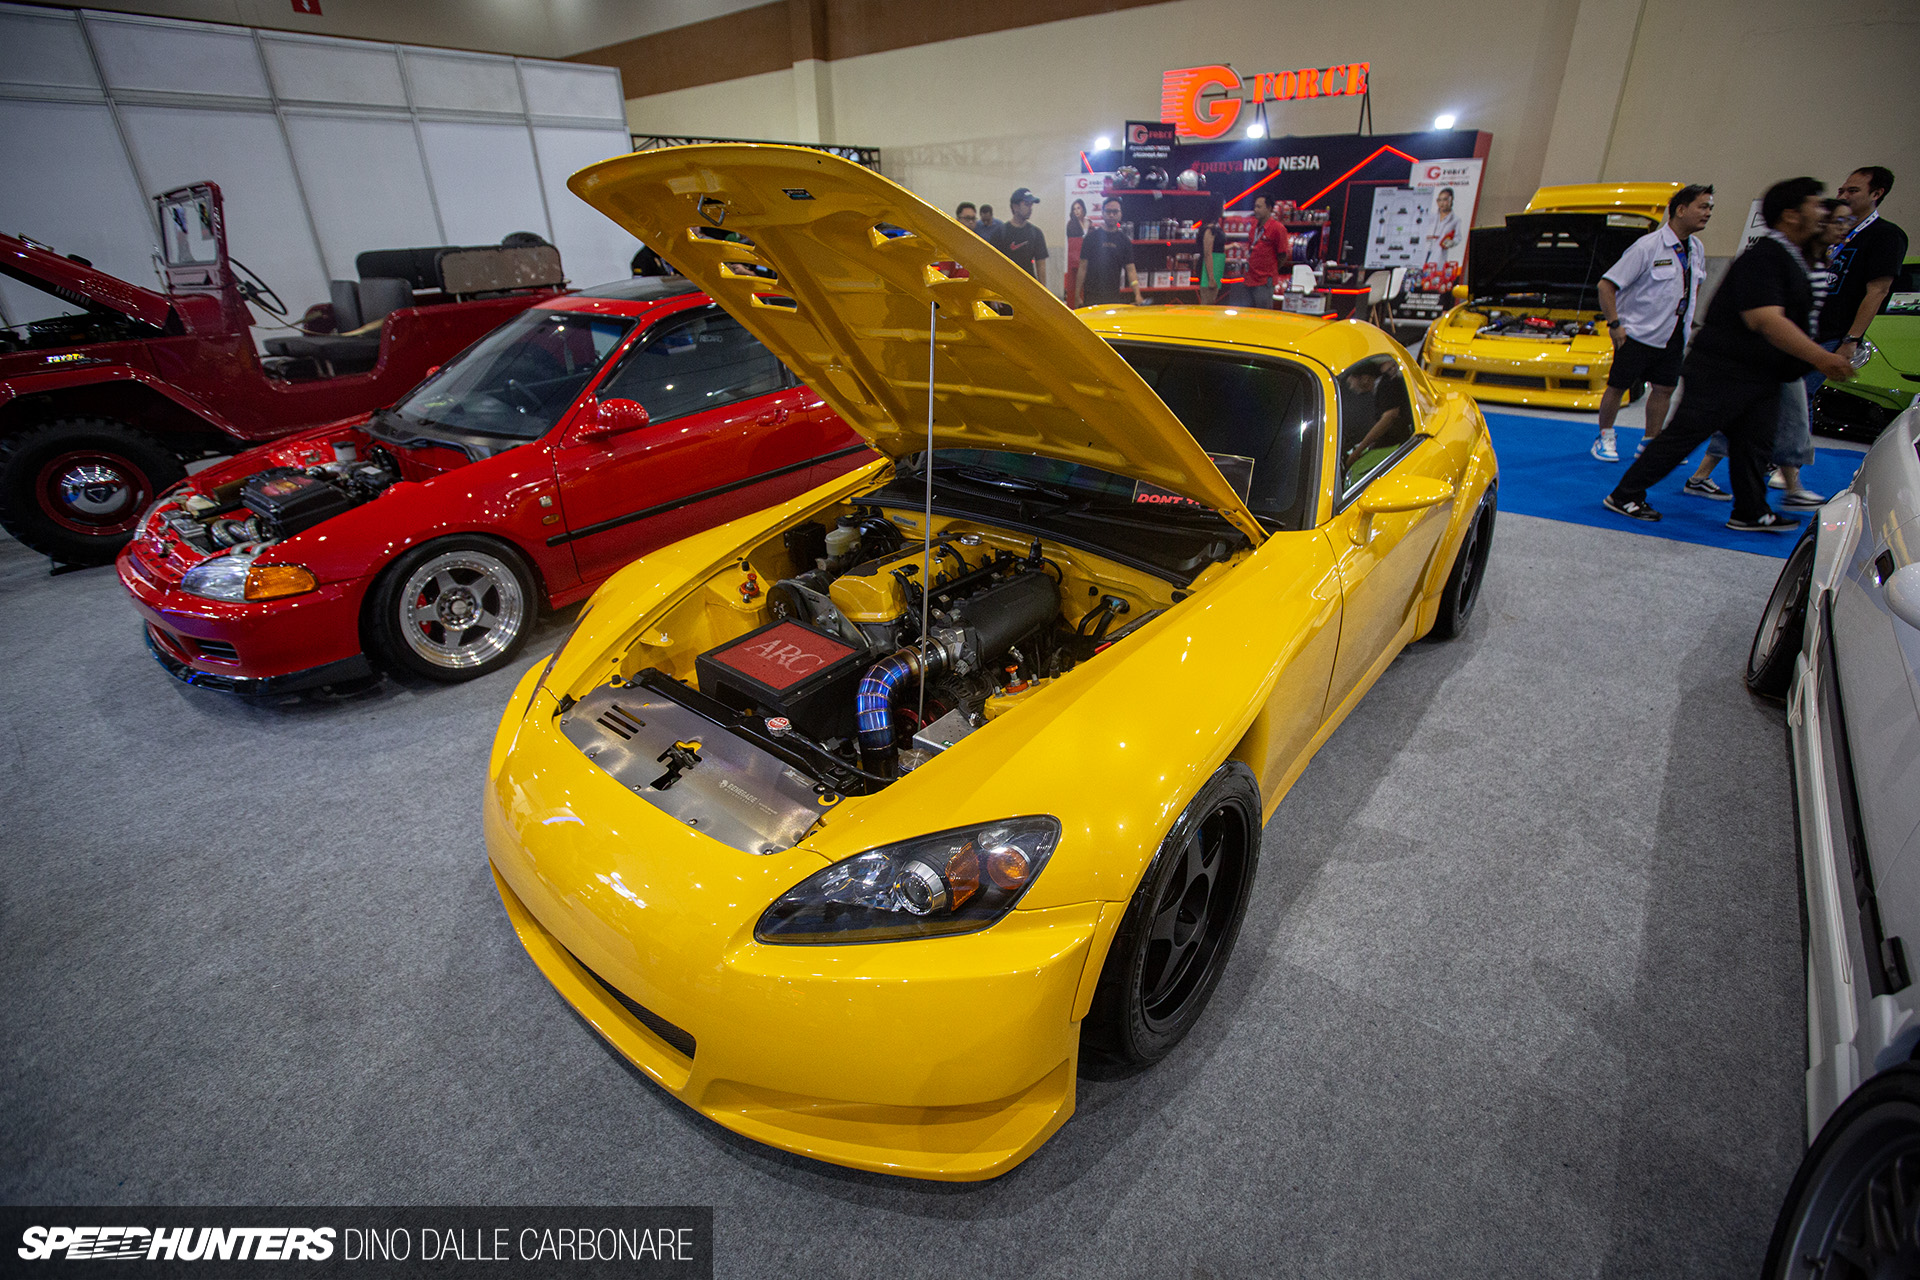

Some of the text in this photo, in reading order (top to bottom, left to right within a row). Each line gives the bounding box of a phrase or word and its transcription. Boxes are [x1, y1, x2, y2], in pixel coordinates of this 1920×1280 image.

[1161, 62, 1370, 139] G FORCE
[1128, 124, 1148, 144] G
[1425, 166, 1441, 180] G
[743, 639, 825, 675] ARC
